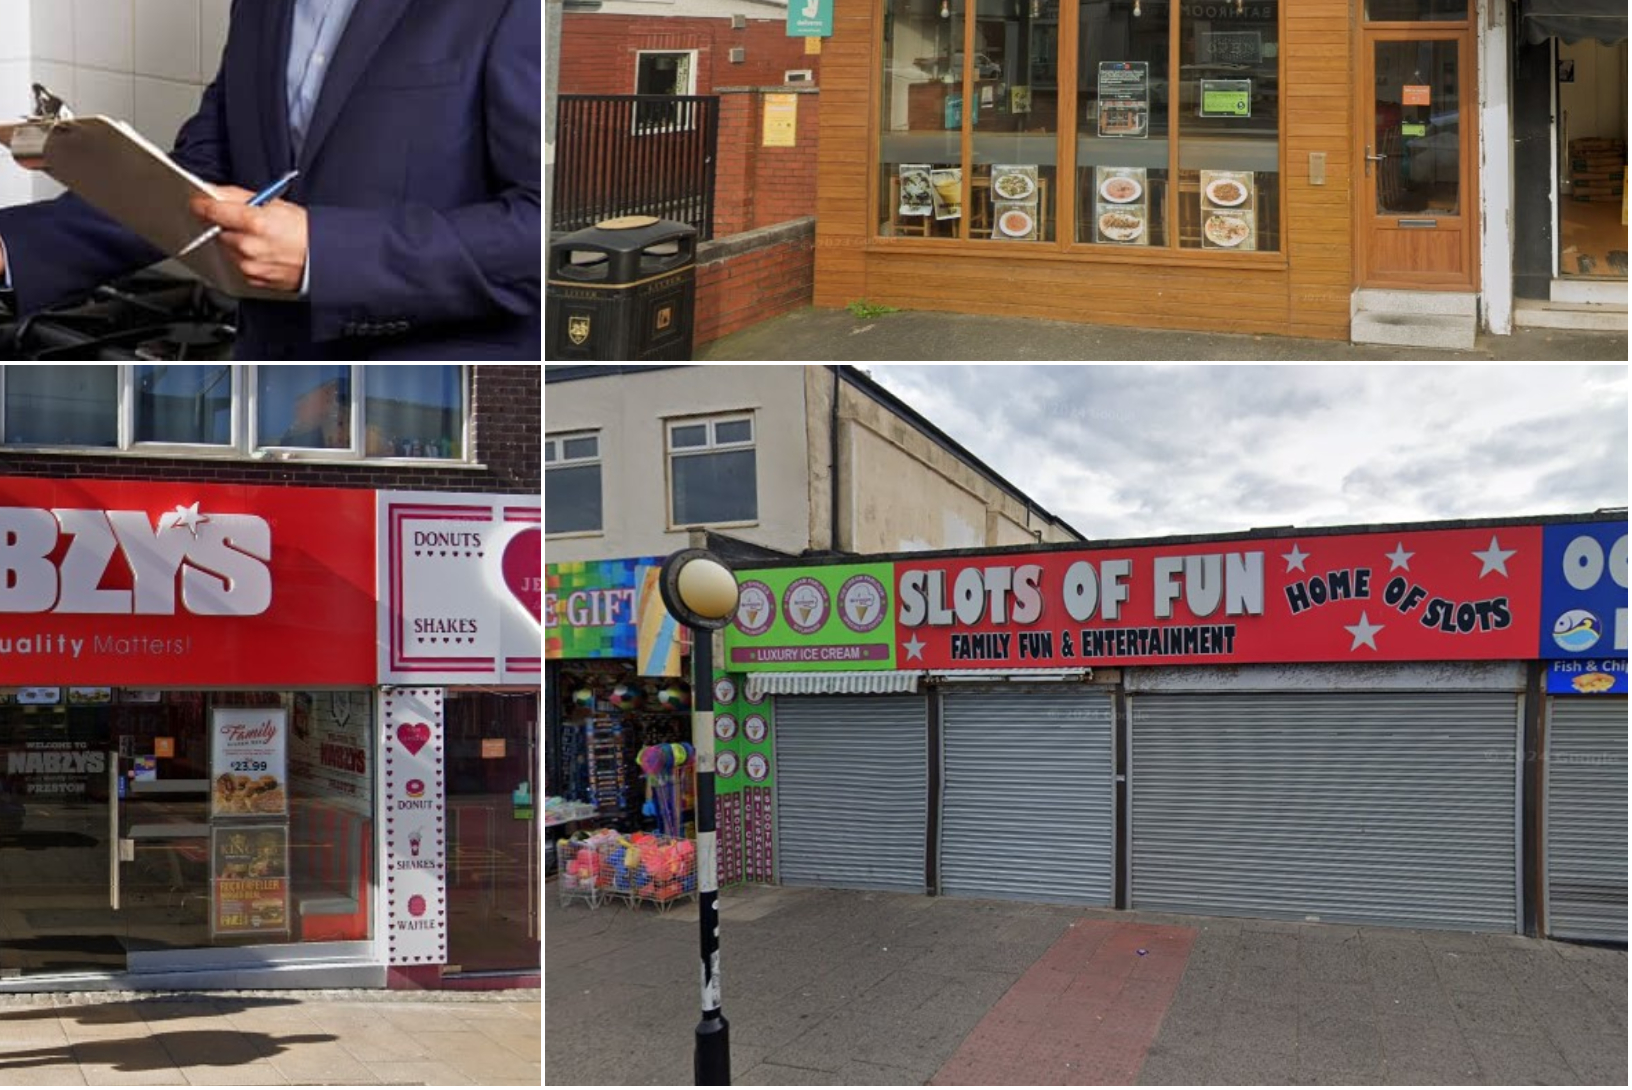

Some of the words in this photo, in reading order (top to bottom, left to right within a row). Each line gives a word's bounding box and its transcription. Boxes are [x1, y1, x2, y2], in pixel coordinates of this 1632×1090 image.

[415, 531, 481, 547] DONUTS
[898, 566, 1044, 627] SLOTS
[1063, 558, 1131, 623] OF
[1153, 551, 1265, 618] FUN
[1284, 567, 1372, 615] HOME
[1383, 575, 1424, 613] OF
[1421, 595, 1513, 633] SLOTS
[414, 618, 478, 633] SHAKES
[94, 633, 191, 656] Matters!
[757, 650, 798, 661] LUXURY
[800, 649, 819, 660] ICE
[820, 647, 860, 659] CREAM
[950, 632, 1011, 661] FAMILY
[1018, 631, 1054, 659] FUN
[1061, 630, 1075, 657] &
[1082, 624, 1237, 658] ENTERTAINMENT
[1554, 661, 1582, 672] Fish
[1585, 661, 1598, 672] &
[220, 719, 278, 745] Family
[7, 751, 105, 773] NABZYS
[27, 783, 86, 792] PRESTON
[397, 800, 433, 810] DONUT
[733, 799, 743, 876] SMOOTHIES
[754, 794, 763, 876] MILKSHAKES
[764, 794, 773, 876] SMOOTHIES
[745, 830, 754, 875] CREAM
[396, 859, 435, 870] SHAKES
